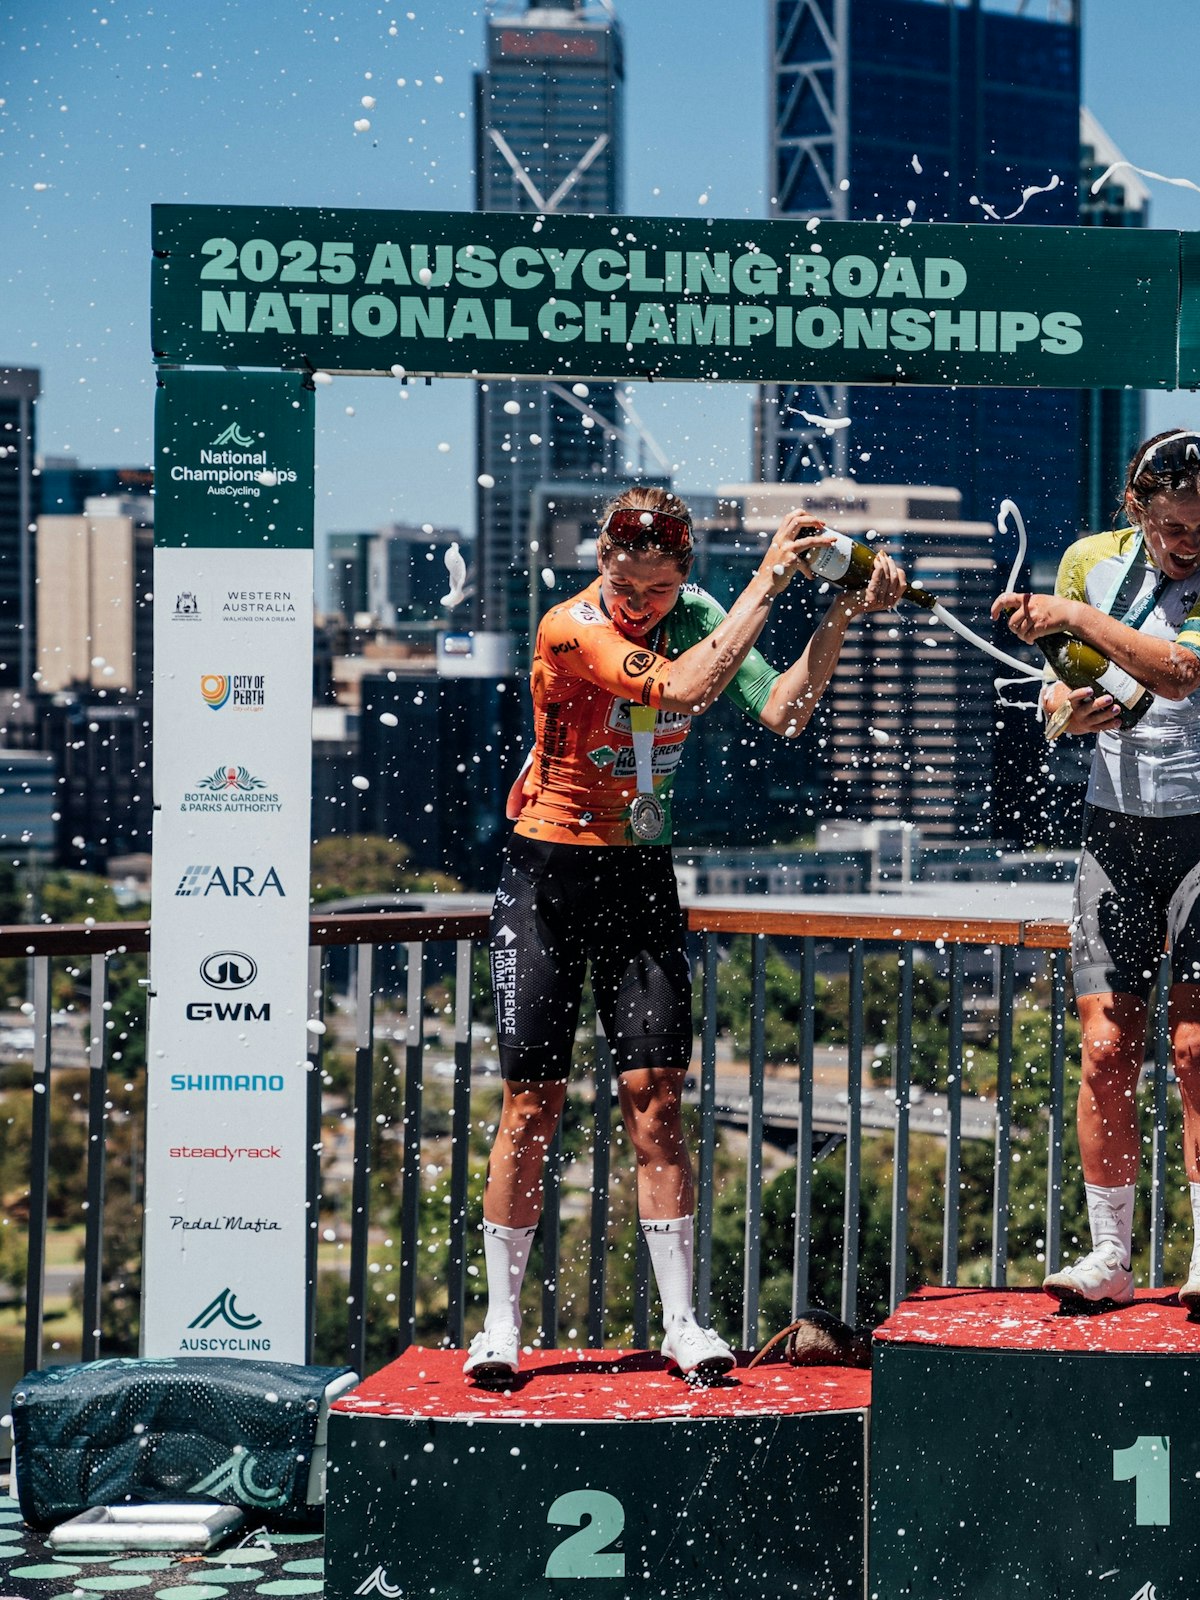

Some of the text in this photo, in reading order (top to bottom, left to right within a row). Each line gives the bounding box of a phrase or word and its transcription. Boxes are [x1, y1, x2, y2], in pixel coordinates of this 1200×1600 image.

[200, 238, 968, 300] 2025 AUSCYCLING ROAD
[201, 290, 1084, 355] NATIONAL CHAMPIONSHIPS
[200, 449, 267, 465] National
[207, 485, 261, 497] AusCycling
[227, 591, 292, 600] WESTERN
[222, 603, 296, 612] AUSTRALIA
[550, 638, 580, 656] POLI
[233, 675, 265, 689] CITY OF
[233, 690, 264, 705] PERTH
[184, 793, 279, 803] BOTANIC GARDENS
[180, 804, 283, 812] & PARKS AUTHORITY
[203, 866, 286, 897] ARA
[495, 950, 505, 990] HOME
[505, 949, 517, 1035] PREFERENCE
[186, 1003, 271, 1021] GWM
[170, 1075, 284, 1092] SHIMANO
[169, 1145, 282, 1162] steadyrack
[169, 1216, 282, 1232] Pedal Mafia
[179, 1338, 271, 1352] AUSCYCLING
[1112, 1435, 1171, 1526] 1
[544, 1489, 626, 1579] 2
